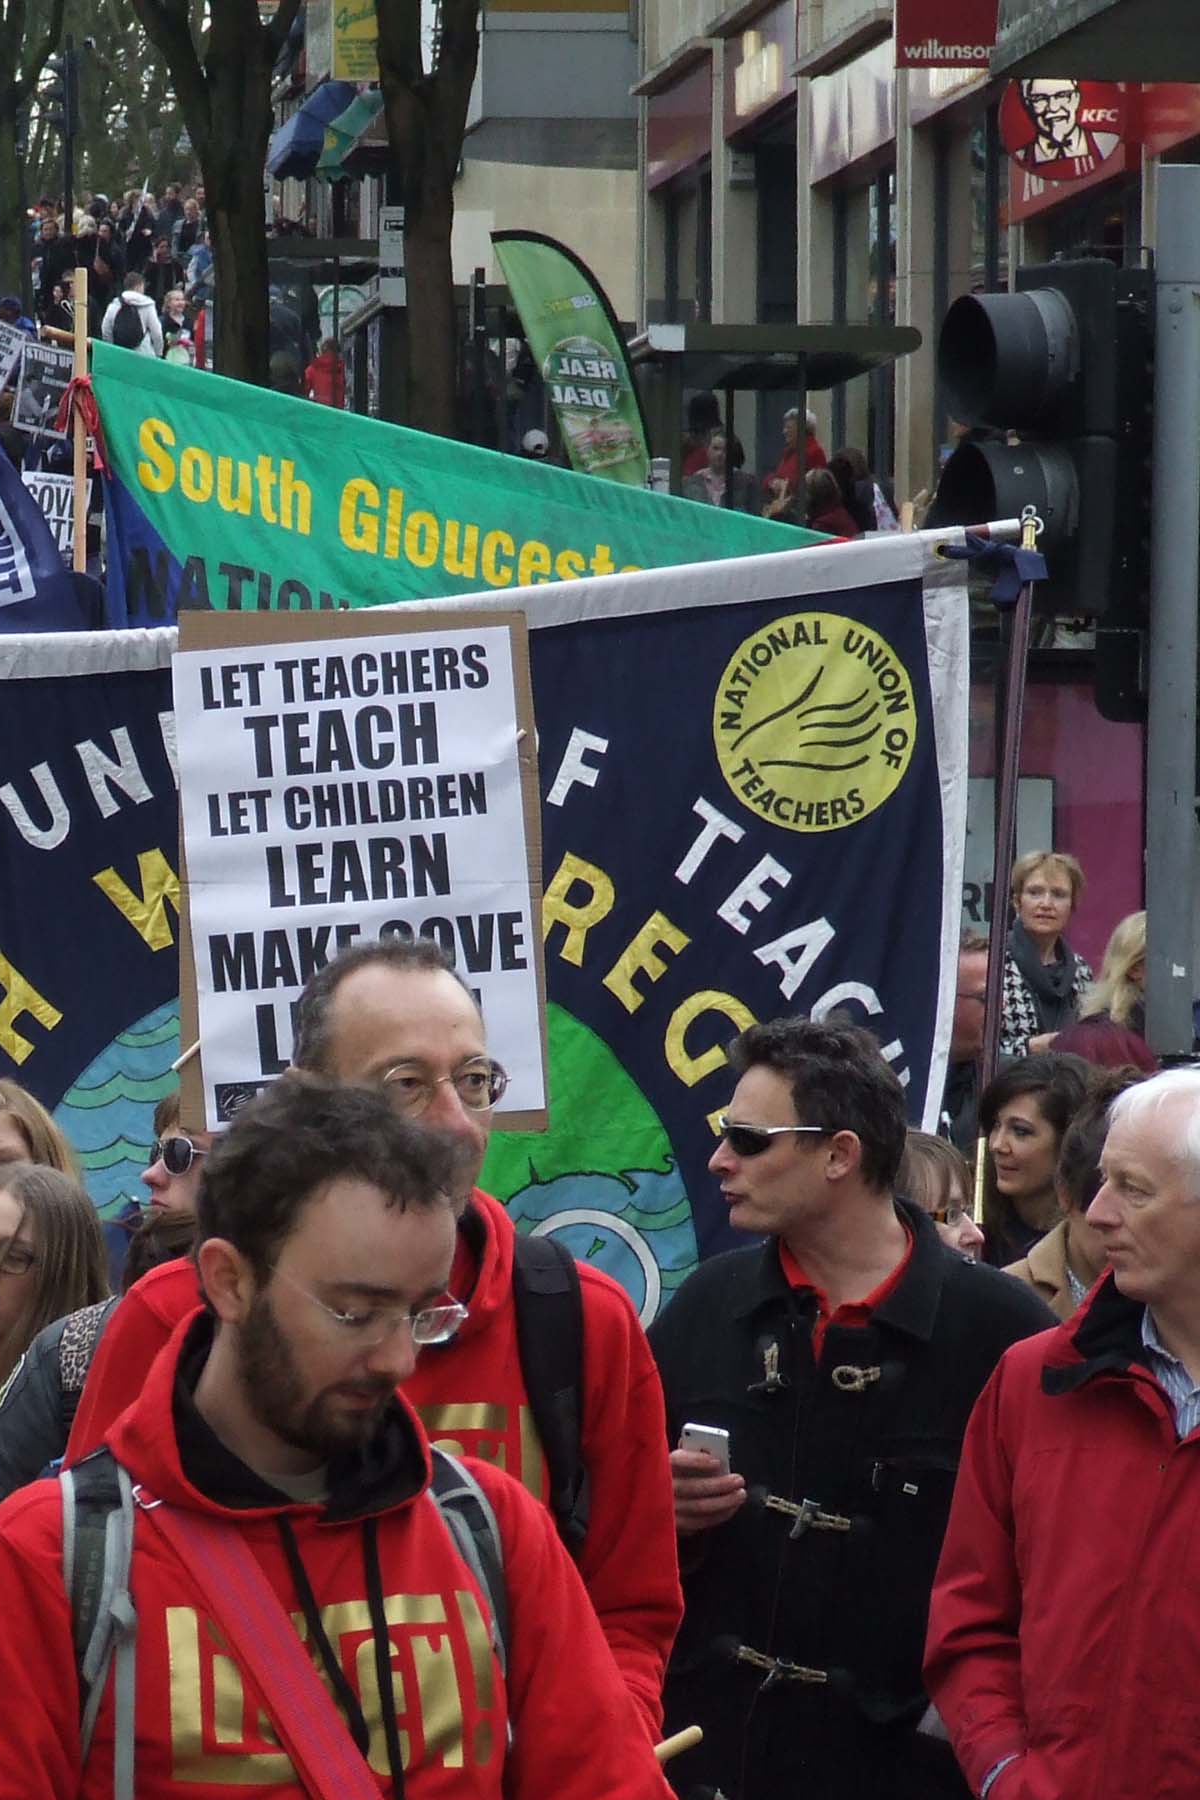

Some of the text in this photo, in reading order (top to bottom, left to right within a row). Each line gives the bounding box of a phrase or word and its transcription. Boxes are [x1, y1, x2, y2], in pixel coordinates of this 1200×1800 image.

[1081, 108, 1120, 123] KFC
[26, 347, 58, 364] STAND
[137, 417, 641, 588] South Gloucest
[200, 644, 490, 710] LET TEACHERS
[243, 702, 440, 778] TEACH
[721, 620, 909, 826] NATIONAL UNION OF TEACHERS
[208, 772, 488, 837] LET CHILDREN
[265, 833, 451, 908] LEARN
